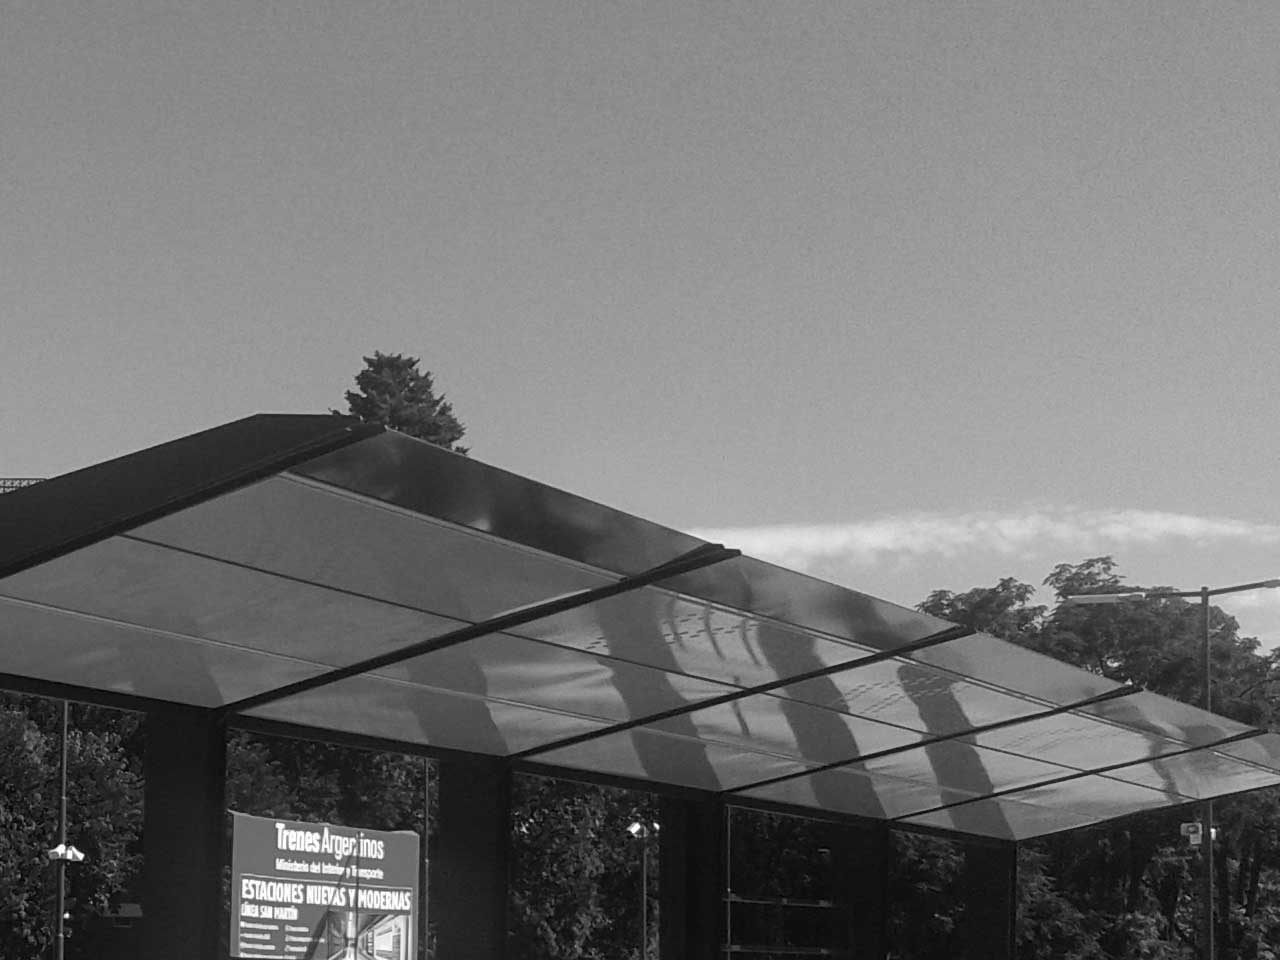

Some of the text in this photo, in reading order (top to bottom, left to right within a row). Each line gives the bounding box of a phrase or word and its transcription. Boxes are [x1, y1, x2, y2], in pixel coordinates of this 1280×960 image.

[321, 826, 384, 860] Argeninos
[241, 878, 411, 911] ESTACIONES NUEVAS Y MODERNAS
